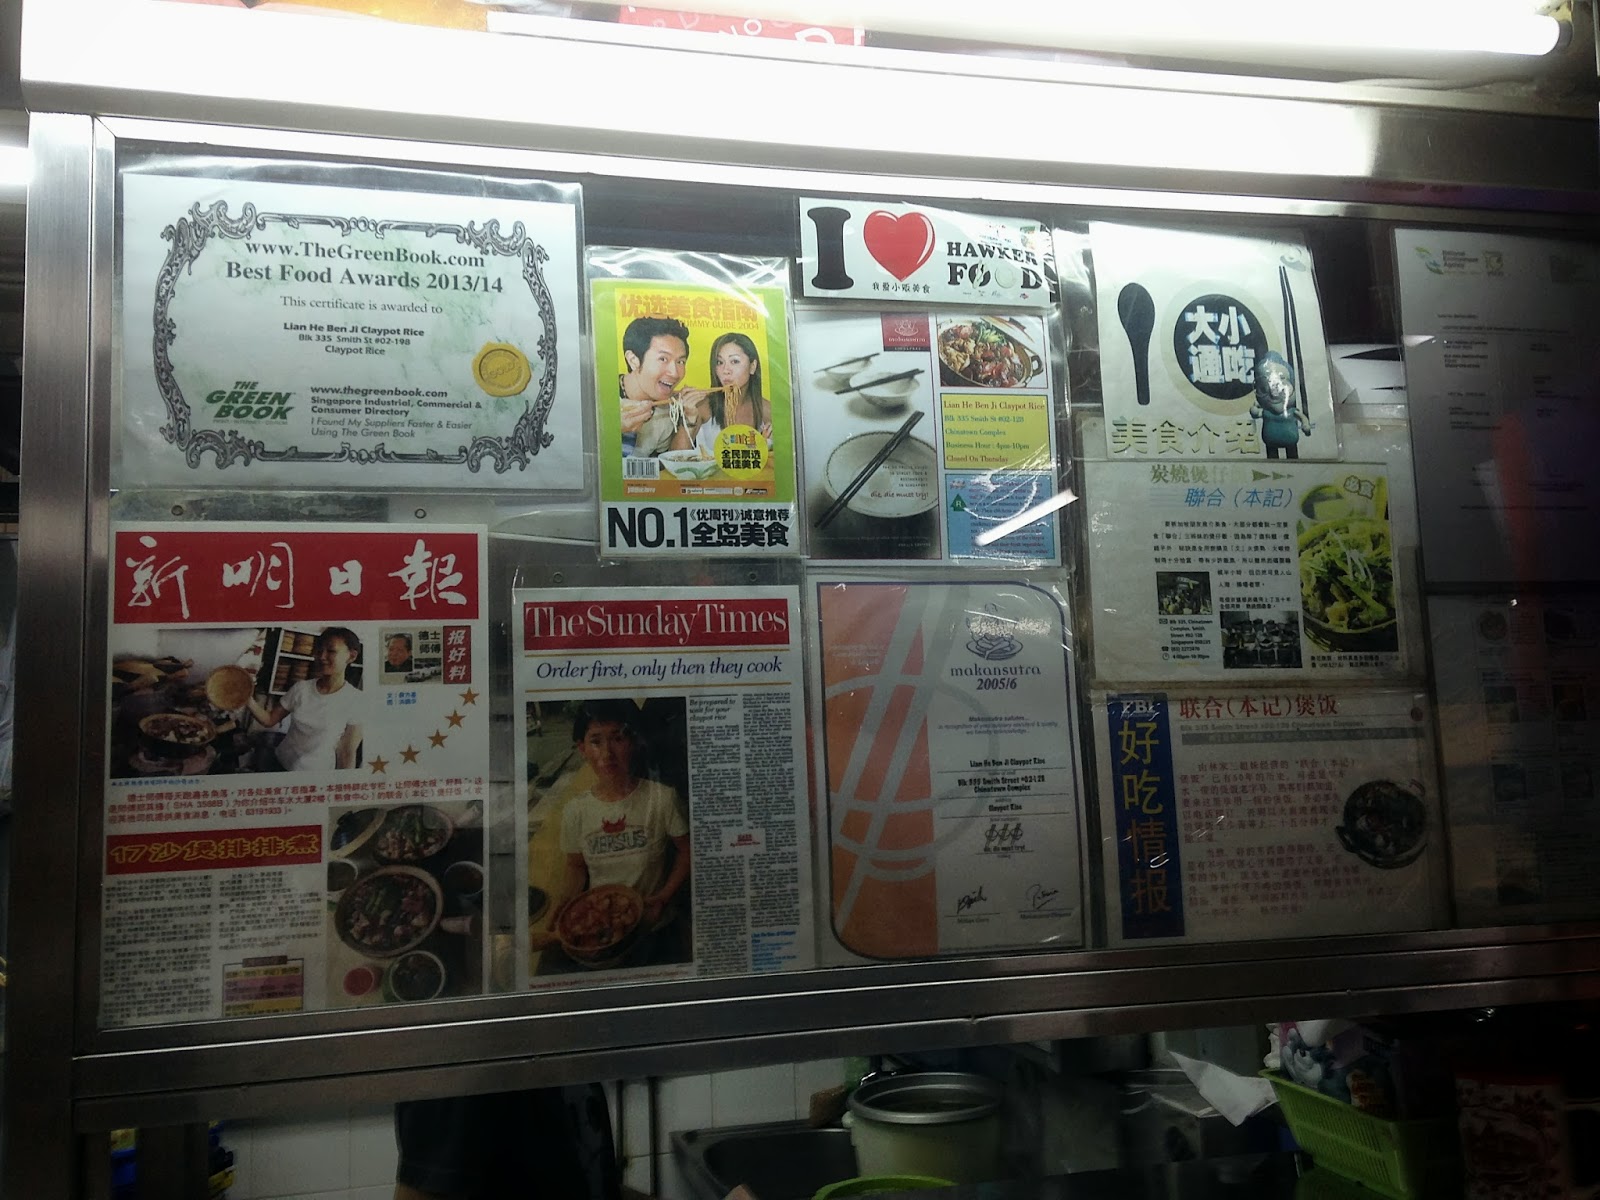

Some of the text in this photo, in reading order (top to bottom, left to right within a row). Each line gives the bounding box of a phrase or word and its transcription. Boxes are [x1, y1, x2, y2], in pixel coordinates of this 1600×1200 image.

[246, 242, 485, 268] www.TheGreenBook.com
[807, 206, 854, 291] I
[947, 241, 1038, 266] HAWKER
[226, 262, 503, 293] Best Food Awards 2013/14
[281, 296, 443, 314] This certificate is awarded to
[283, 322, 425, 336] Lian He Ben Ji Claypot Rice
[1184, 305, 1251, 345] 大小
[337, 335, 362, 343] Smith
[325, 345, 386, 356] Claypot Rice
[1188, 344, 1255, 383] 通吃
[234, 381, 259, 390] THE
[310, 386, 448, 398] www.thegreenbook.com
[205, 390, 292, 405] GREEN
[311, 396, 482, 409] Singapore Industrial, Commercial &
[944, 400, 1045, 411] Lian He Ben Ji Claypot Rice
[214, 405, 294, 419] BOOK
[311, 406, 411, 418] Consumer Directory
[316, 417, 346, 427] Found
[348, 418, 362, 428] My
[364, 418, 405, 429] Suppliers
[407, 420, 435, 429] Faster
[446, 421, 473, 430] Easier
[311, 428, 416, 438] Using The Green Book
[1151, 463, 1243, 484] 炭燒煲仔
[1184, 487, 1293, 508] 聯合（本記）
[607, 507, 688, 548] NO.1
[691, 521, 789, 547] 全岛美食
[125, 535, 468, 620] 新明日報
[526, 602, 787, 645] The Sunday Times
[447, 629, 466, 681] 报好料
[537, 655, 783, 683] Order first, only then they cook
[950, 663, 1042, 677] makansutra
[976, 678, 1017, 690] 2005/6
[699, 697, 728, 708] prepared
[1180, 694, 1338, 719] 联合（本记）煲饭
[974, 784, 1030, 793] Chinatown Complex
[988, 804, 1009, 812] Claypot
[1118, 720, 1172, 915] 好吃情报
